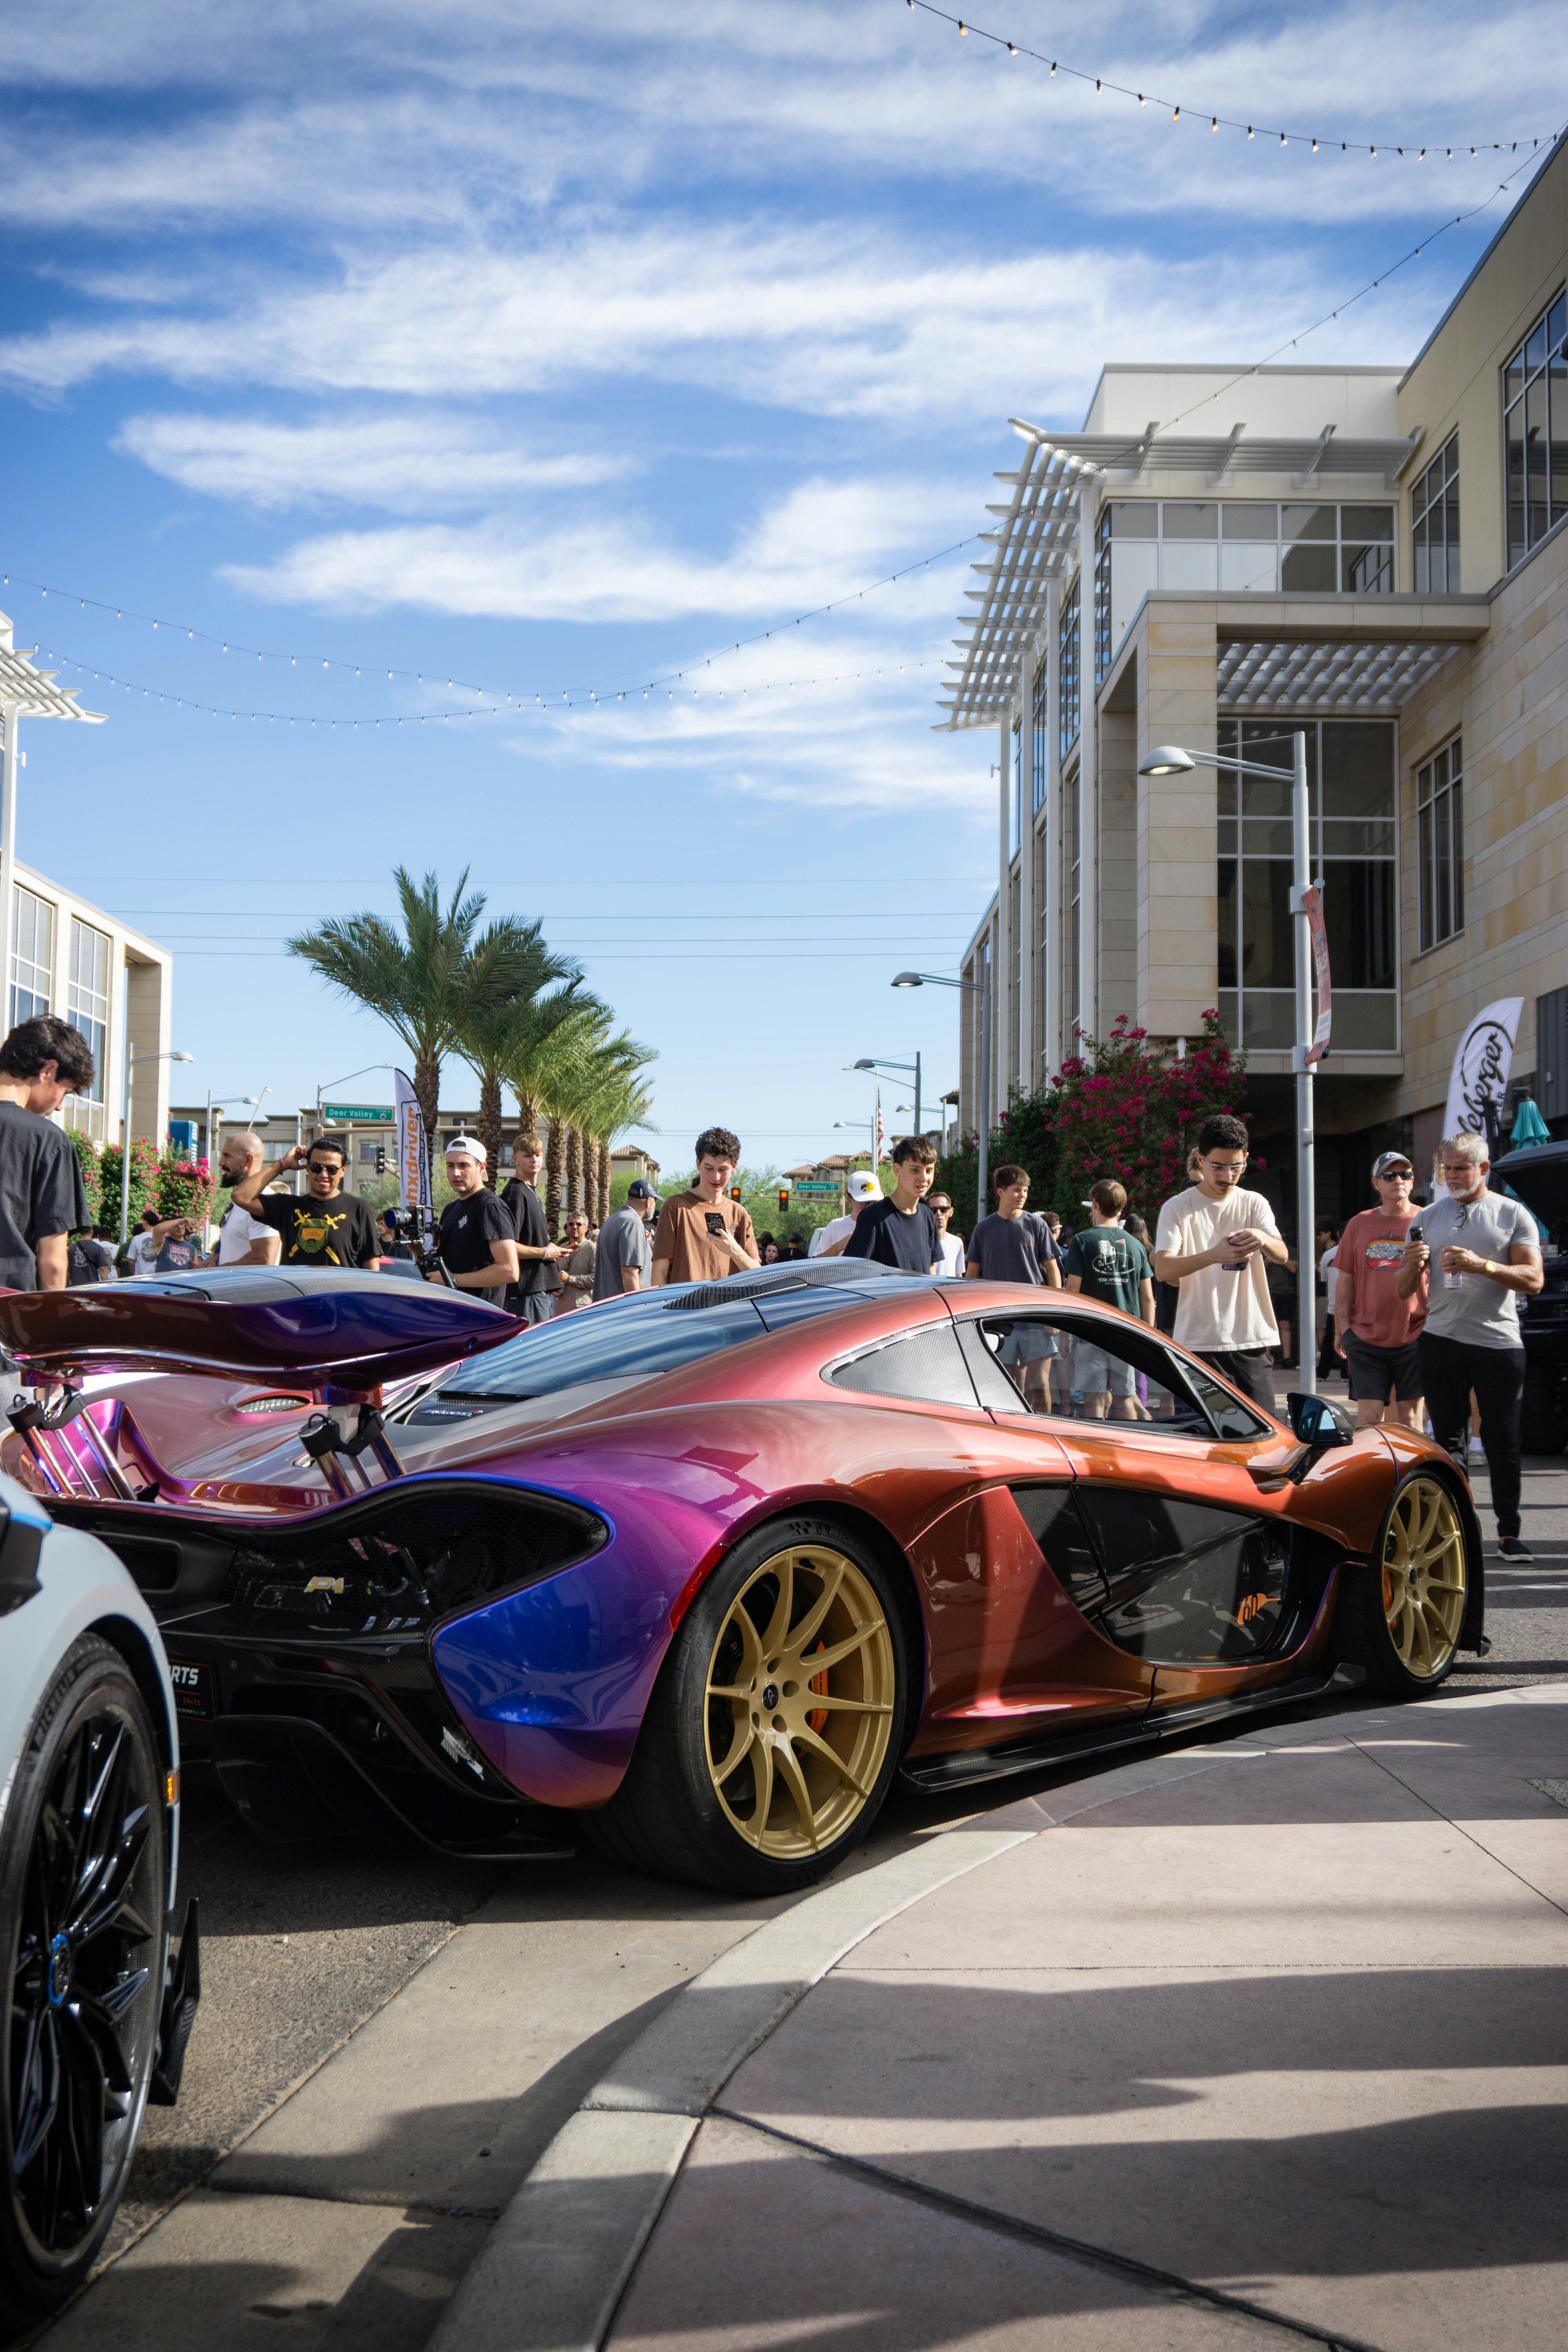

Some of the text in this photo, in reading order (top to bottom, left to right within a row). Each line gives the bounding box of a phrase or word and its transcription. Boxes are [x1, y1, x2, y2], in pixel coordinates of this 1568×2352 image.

[349, 1110, 373, 1119] Valley
[303, 1575, 344, 1594] P1
[169, 1664, 200, 1685] RTS
